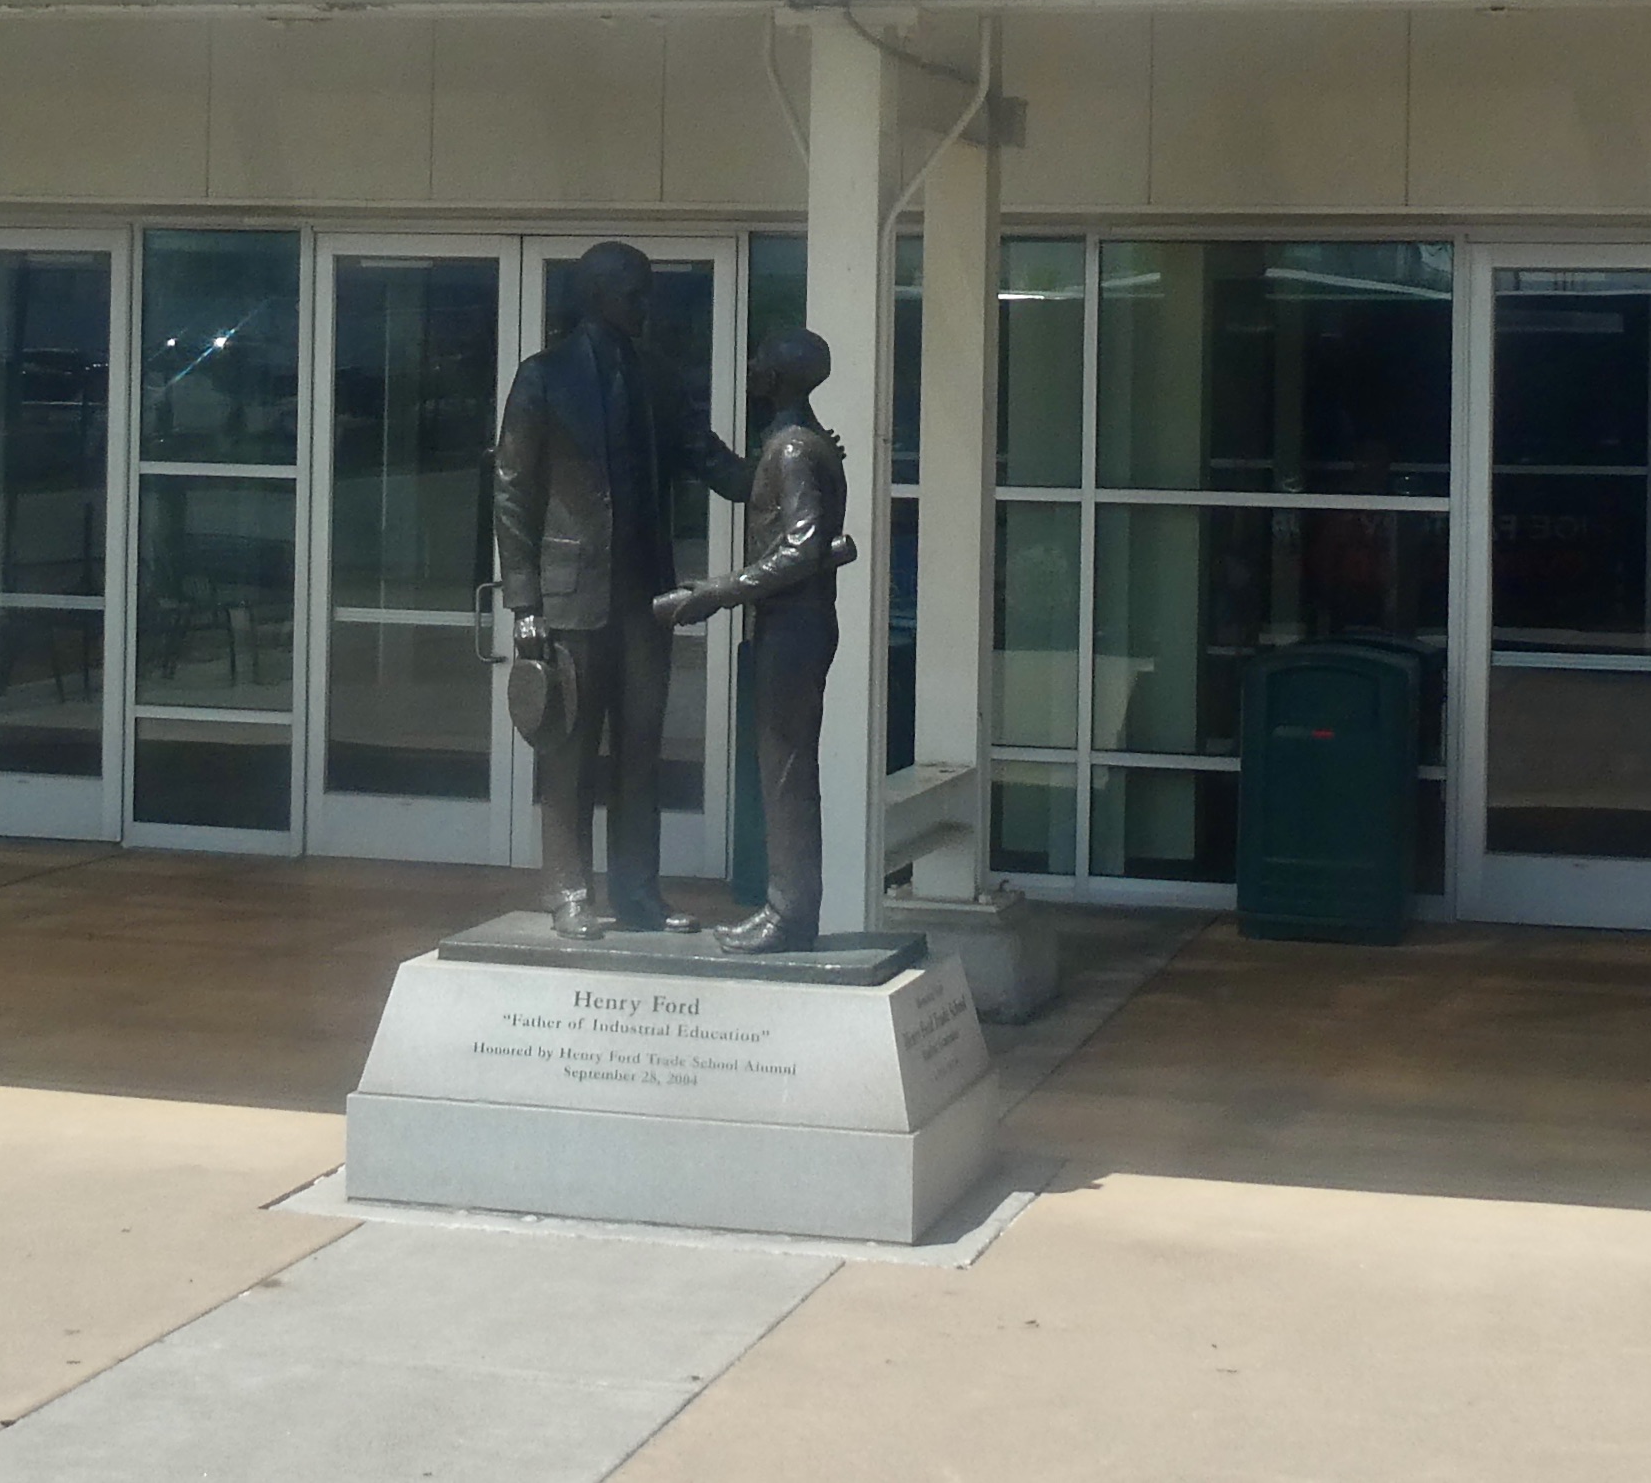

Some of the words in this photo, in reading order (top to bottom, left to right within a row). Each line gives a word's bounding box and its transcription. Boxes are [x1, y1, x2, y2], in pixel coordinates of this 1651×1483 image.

[573, 990, 642, 1017] Henry
[652, 994, 700, 1016] Ford
[567, 1017, 586, 1030] of
[592, 1018, 670, 1037] Industrial
[473, 1041, 532, 1057] Honored
[537, 1046, 553, 1062] by
[559, 1047, 602, 1065] Henry
[609, 1050, 641, 1065] Ford
[646, 1052, 686, 1067] Trade
[692, 1055, 738, 1071] School
[744, 1060, 797, 1076] Alumni
[563, 1066, 636, 1082] September
[640, 1071, 661, 1086] 28,
[666, 1071, 698, 1087] 2004
